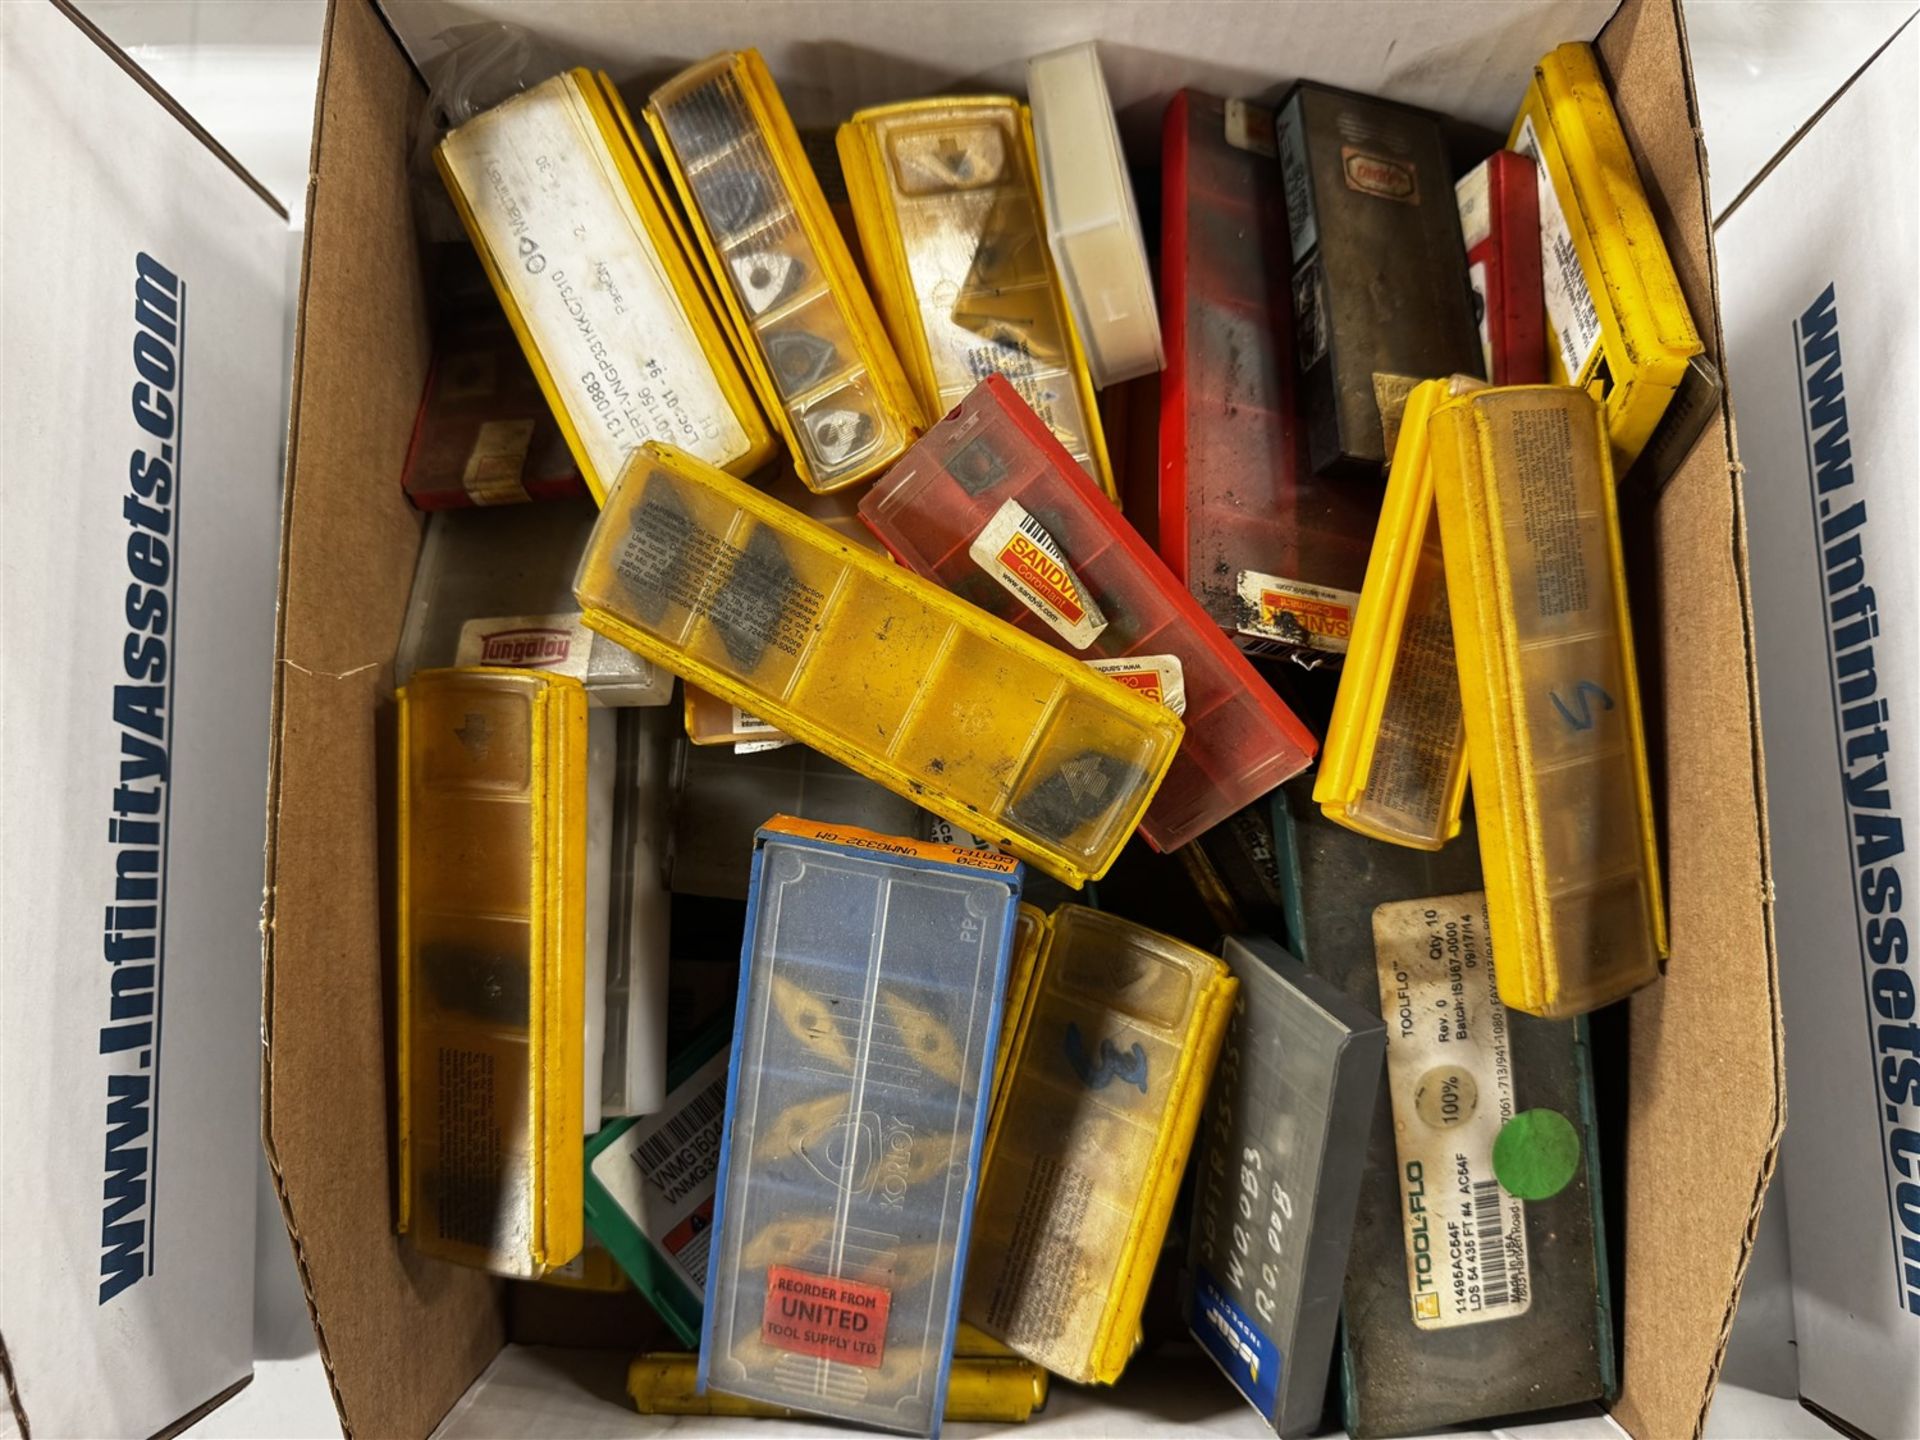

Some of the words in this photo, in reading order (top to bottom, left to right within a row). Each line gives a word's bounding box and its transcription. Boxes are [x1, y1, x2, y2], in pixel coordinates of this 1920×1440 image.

[549, 268, 651, 440] ERT-VNGP331KKC7310
[579, 369, 626, 439] 1310883
[1010, 536, 1080, 604] SANDVI
[1017, 563, 1066, 607] Coromant
[1002, 571, 1058, 622] www.sandvik.com
[479, 626, 572, 664] Tungaloy
[98, 251, 178, 1306] www.InfinityAssets.com
[951, 846, 1014, 865] COATED
[956, 855, 1009, 872] NC320
[1424, 909, 1437, 926] 10
[1427, 930, 1444, 960] Qty.
[1460, 914, 1476, 968] 09/17/14
[1435, 999, 1446, 1007] 0
[1436, 1013, 1449, 1042] Rev.
[1439, 1075, 1461, 1123] 100%
[1498, 1097, 1511, 1125] 7061
[648, 1119, 724, 1189] VNMG1604
[879, 1114, 914, 1211] KORLOY
[1456, 1151, 1471, 1194] AC54F
[1460, 1201, 1471, 1216] #4
[1509, 1205, 1521, 1233] Road
[1462, 1220, 1473, 1236] FT
[1447, 1220, 1467, 1314] 11495AC54F
[1464, 1240, 1475, 1262] 435
[1467, 1265, 1477, 1280] 54
[776, 1276, 837, 1302] REORDER
[840, 1290, 877, 1310] FROM
[1468, 1284, 1481, 1311] LDS
[778, 1294, 870, 1336] UNITED
[766, 1321, 801, 1340] TOOL
[802, 1328, 849, 1351] SUPPLY
